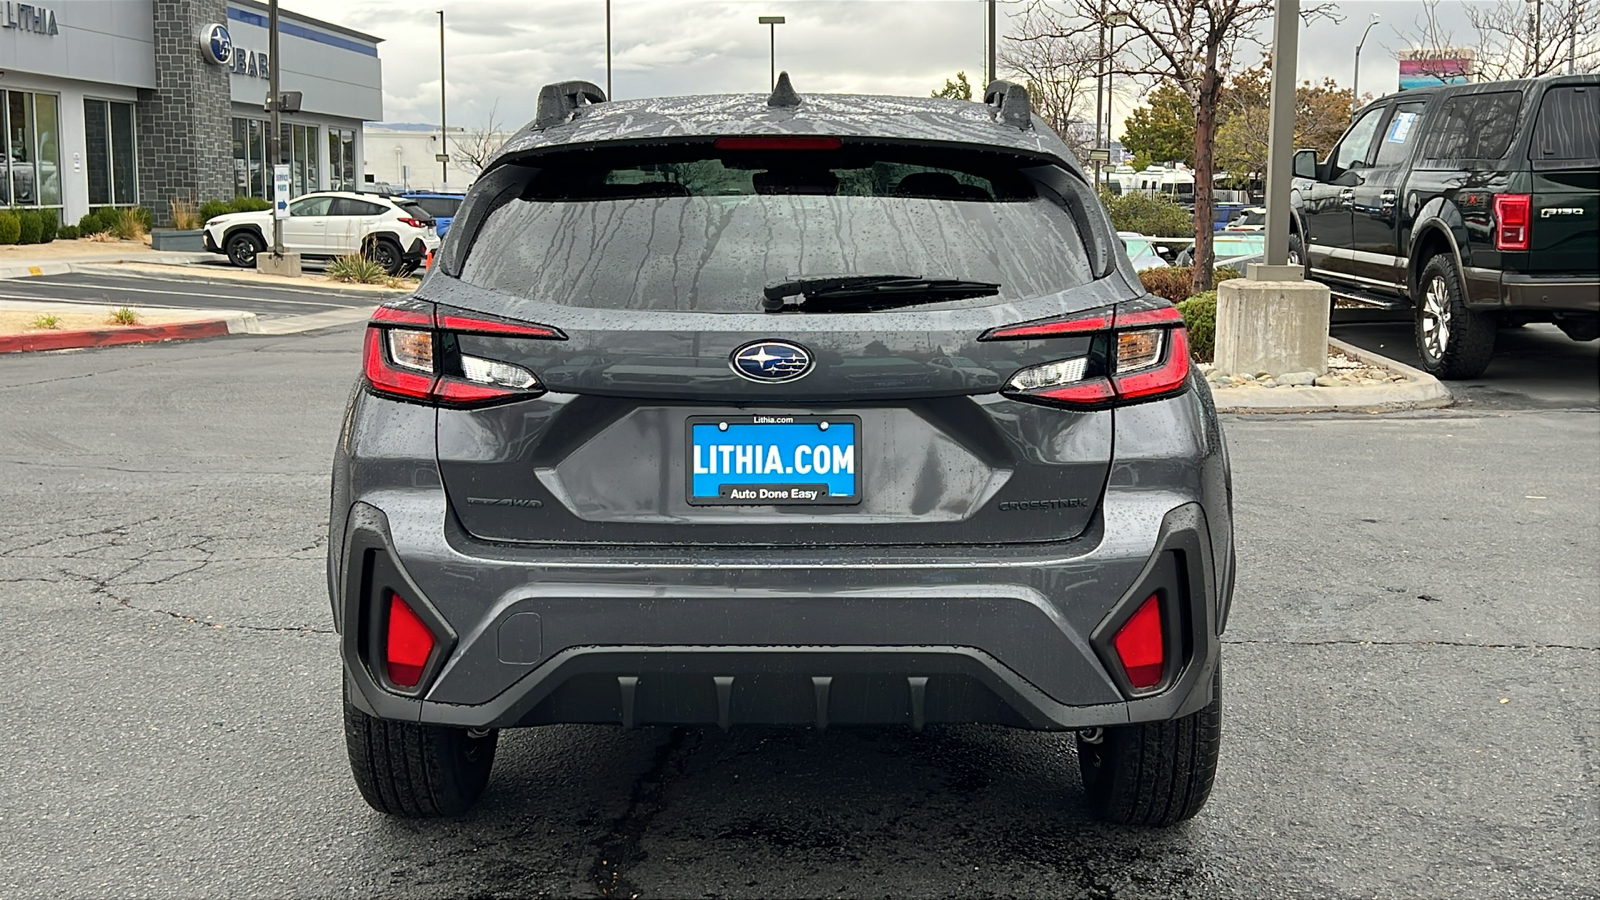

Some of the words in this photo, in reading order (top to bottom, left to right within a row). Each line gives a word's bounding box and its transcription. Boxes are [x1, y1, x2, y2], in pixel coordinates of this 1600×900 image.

[2, 1, 59, 36] LITHIA
[753, 416, 794, 424] Lithia.com
[693, 445, 855, 475] LITHIA.COM
[730, 488, 757, 499] Auto
[761, 489, 789, 499] Done
[791, 489, 818, 500] Easy
[998, 498, 1088, 511] CROSSTREK
